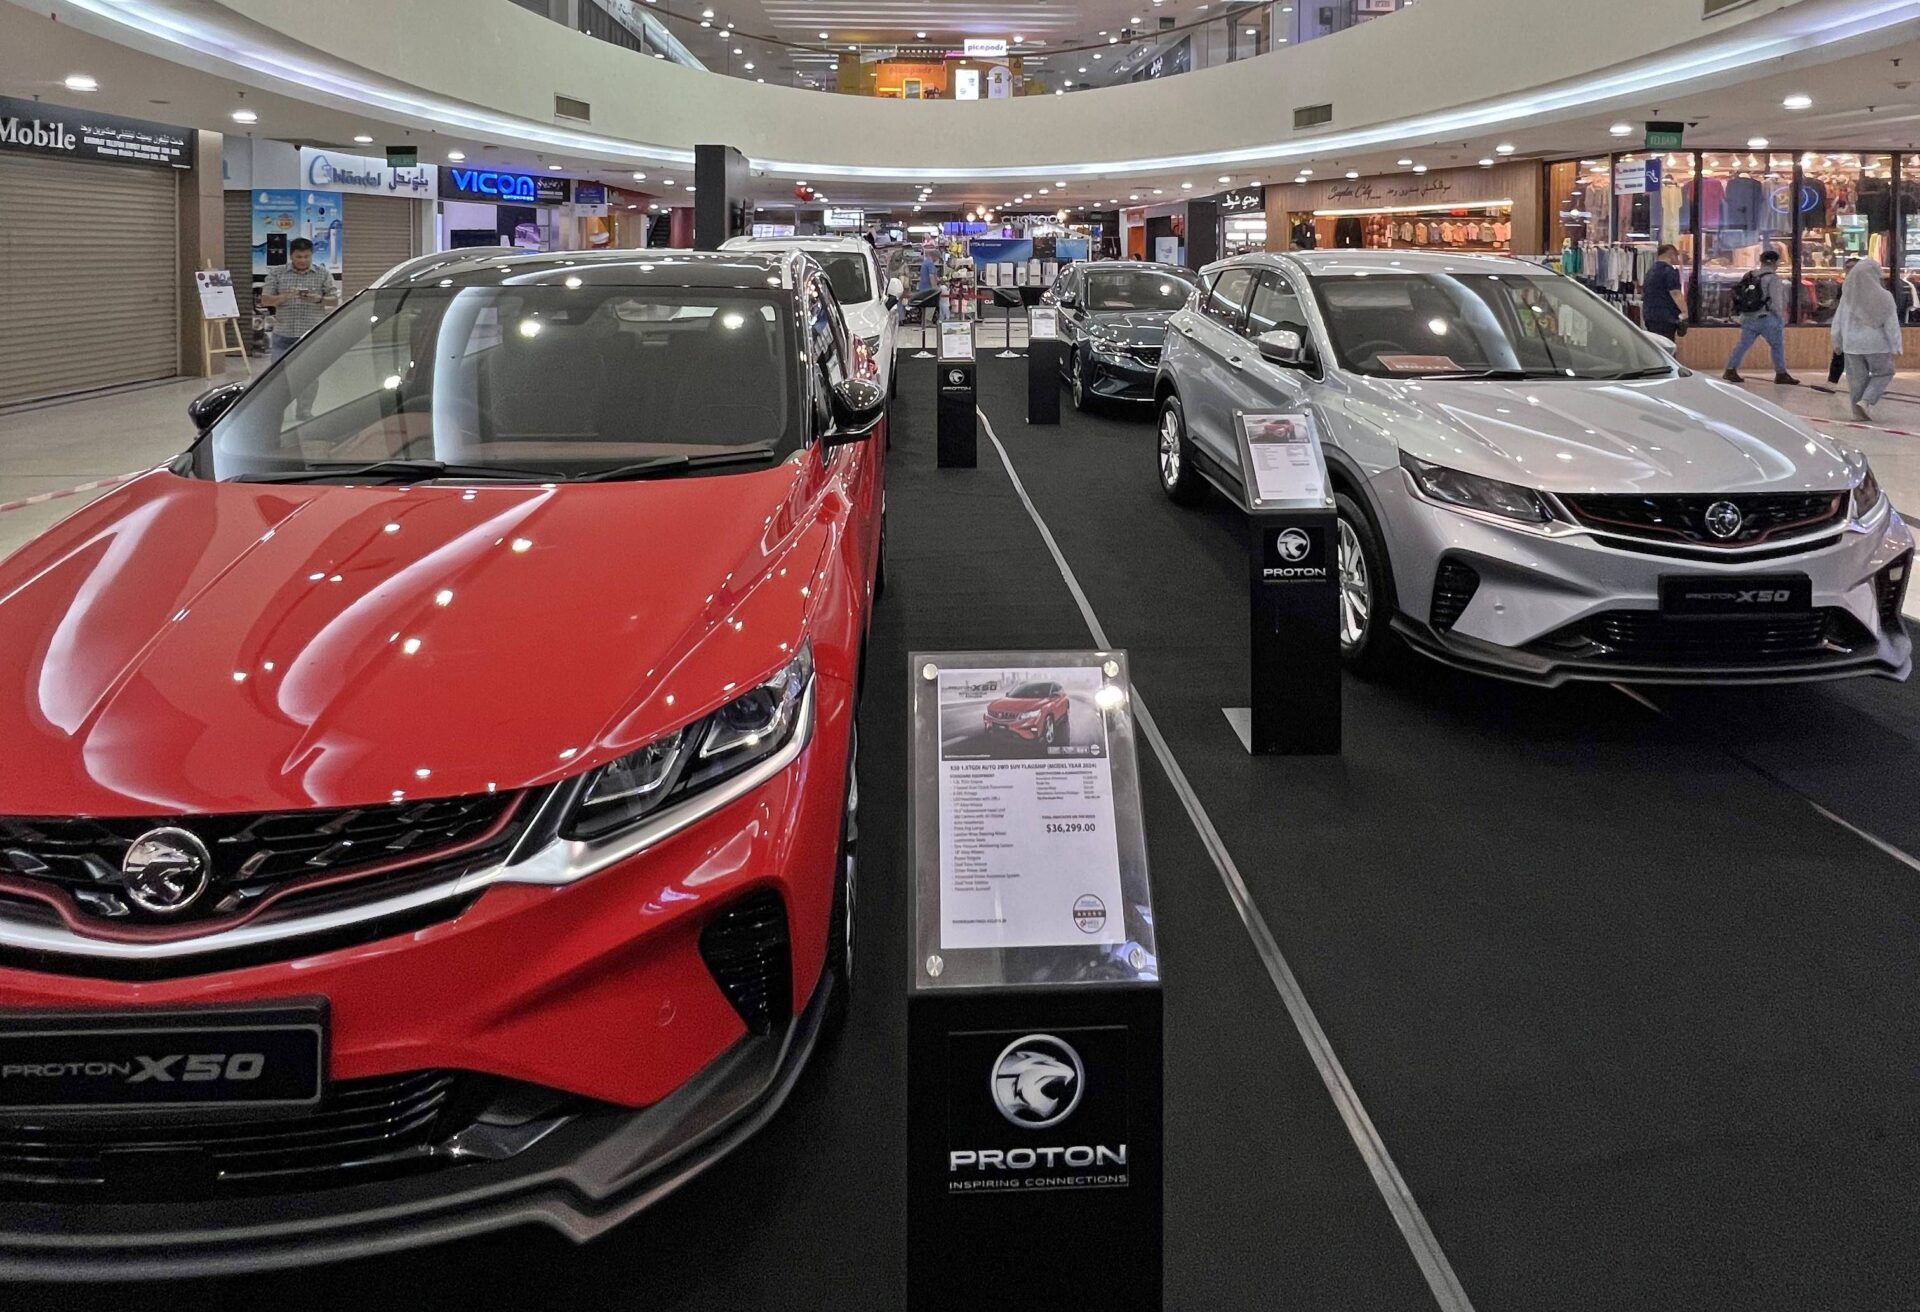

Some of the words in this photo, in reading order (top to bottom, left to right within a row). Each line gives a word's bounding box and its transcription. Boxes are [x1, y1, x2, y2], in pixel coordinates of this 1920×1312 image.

[0, 117, 76, 150] Mobile
[1263, 567, 1327, 577] PROTON
[1735, 590, 1791, 603] X50
[1046, 823, 1096, 833] $36,299.00
[2, 1061, 130, 1079] PROTON
[125, 1053, 266, 1083] X50
[950, 1144, 1127, 1172] PROTON
[950, 1178, 1020, 1190] INSPIRING
[1025, 1174, 1127, 1187] CONNECTIONS
